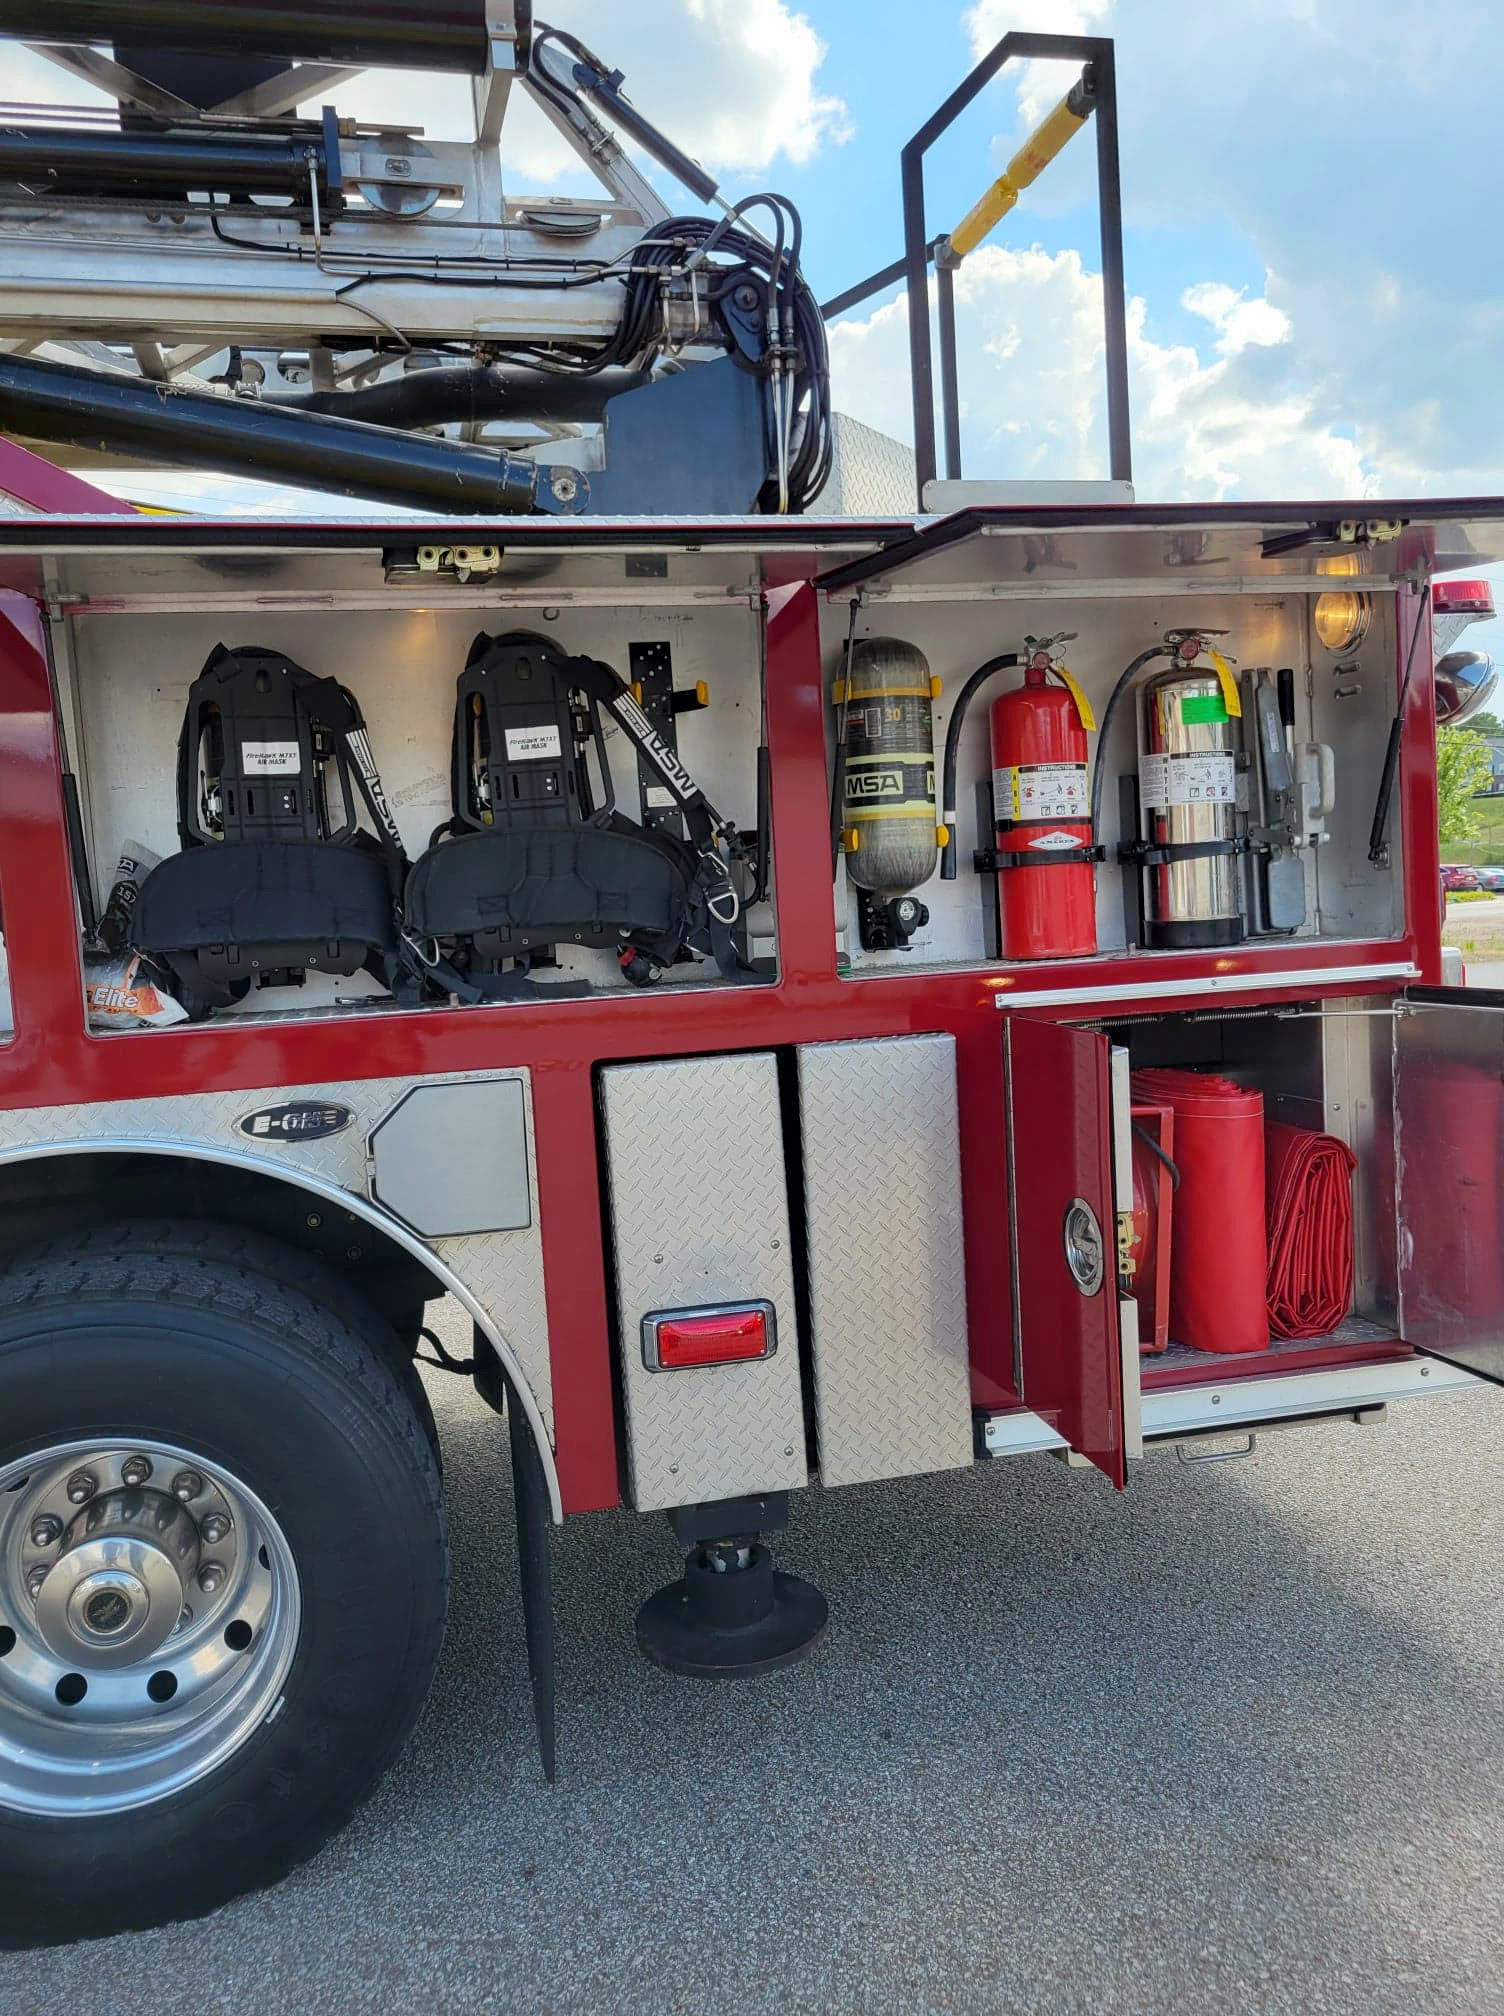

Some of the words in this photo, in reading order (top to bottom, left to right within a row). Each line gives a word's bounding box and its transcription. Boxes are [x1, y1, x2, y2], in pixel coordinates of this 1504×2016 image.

[650, 732, 696, 793] MSA
[847, 774, 900, 795] MSA
[94, 987, 138, 1008] Elite
[252, 1109, 338, 1134] E-ONE
